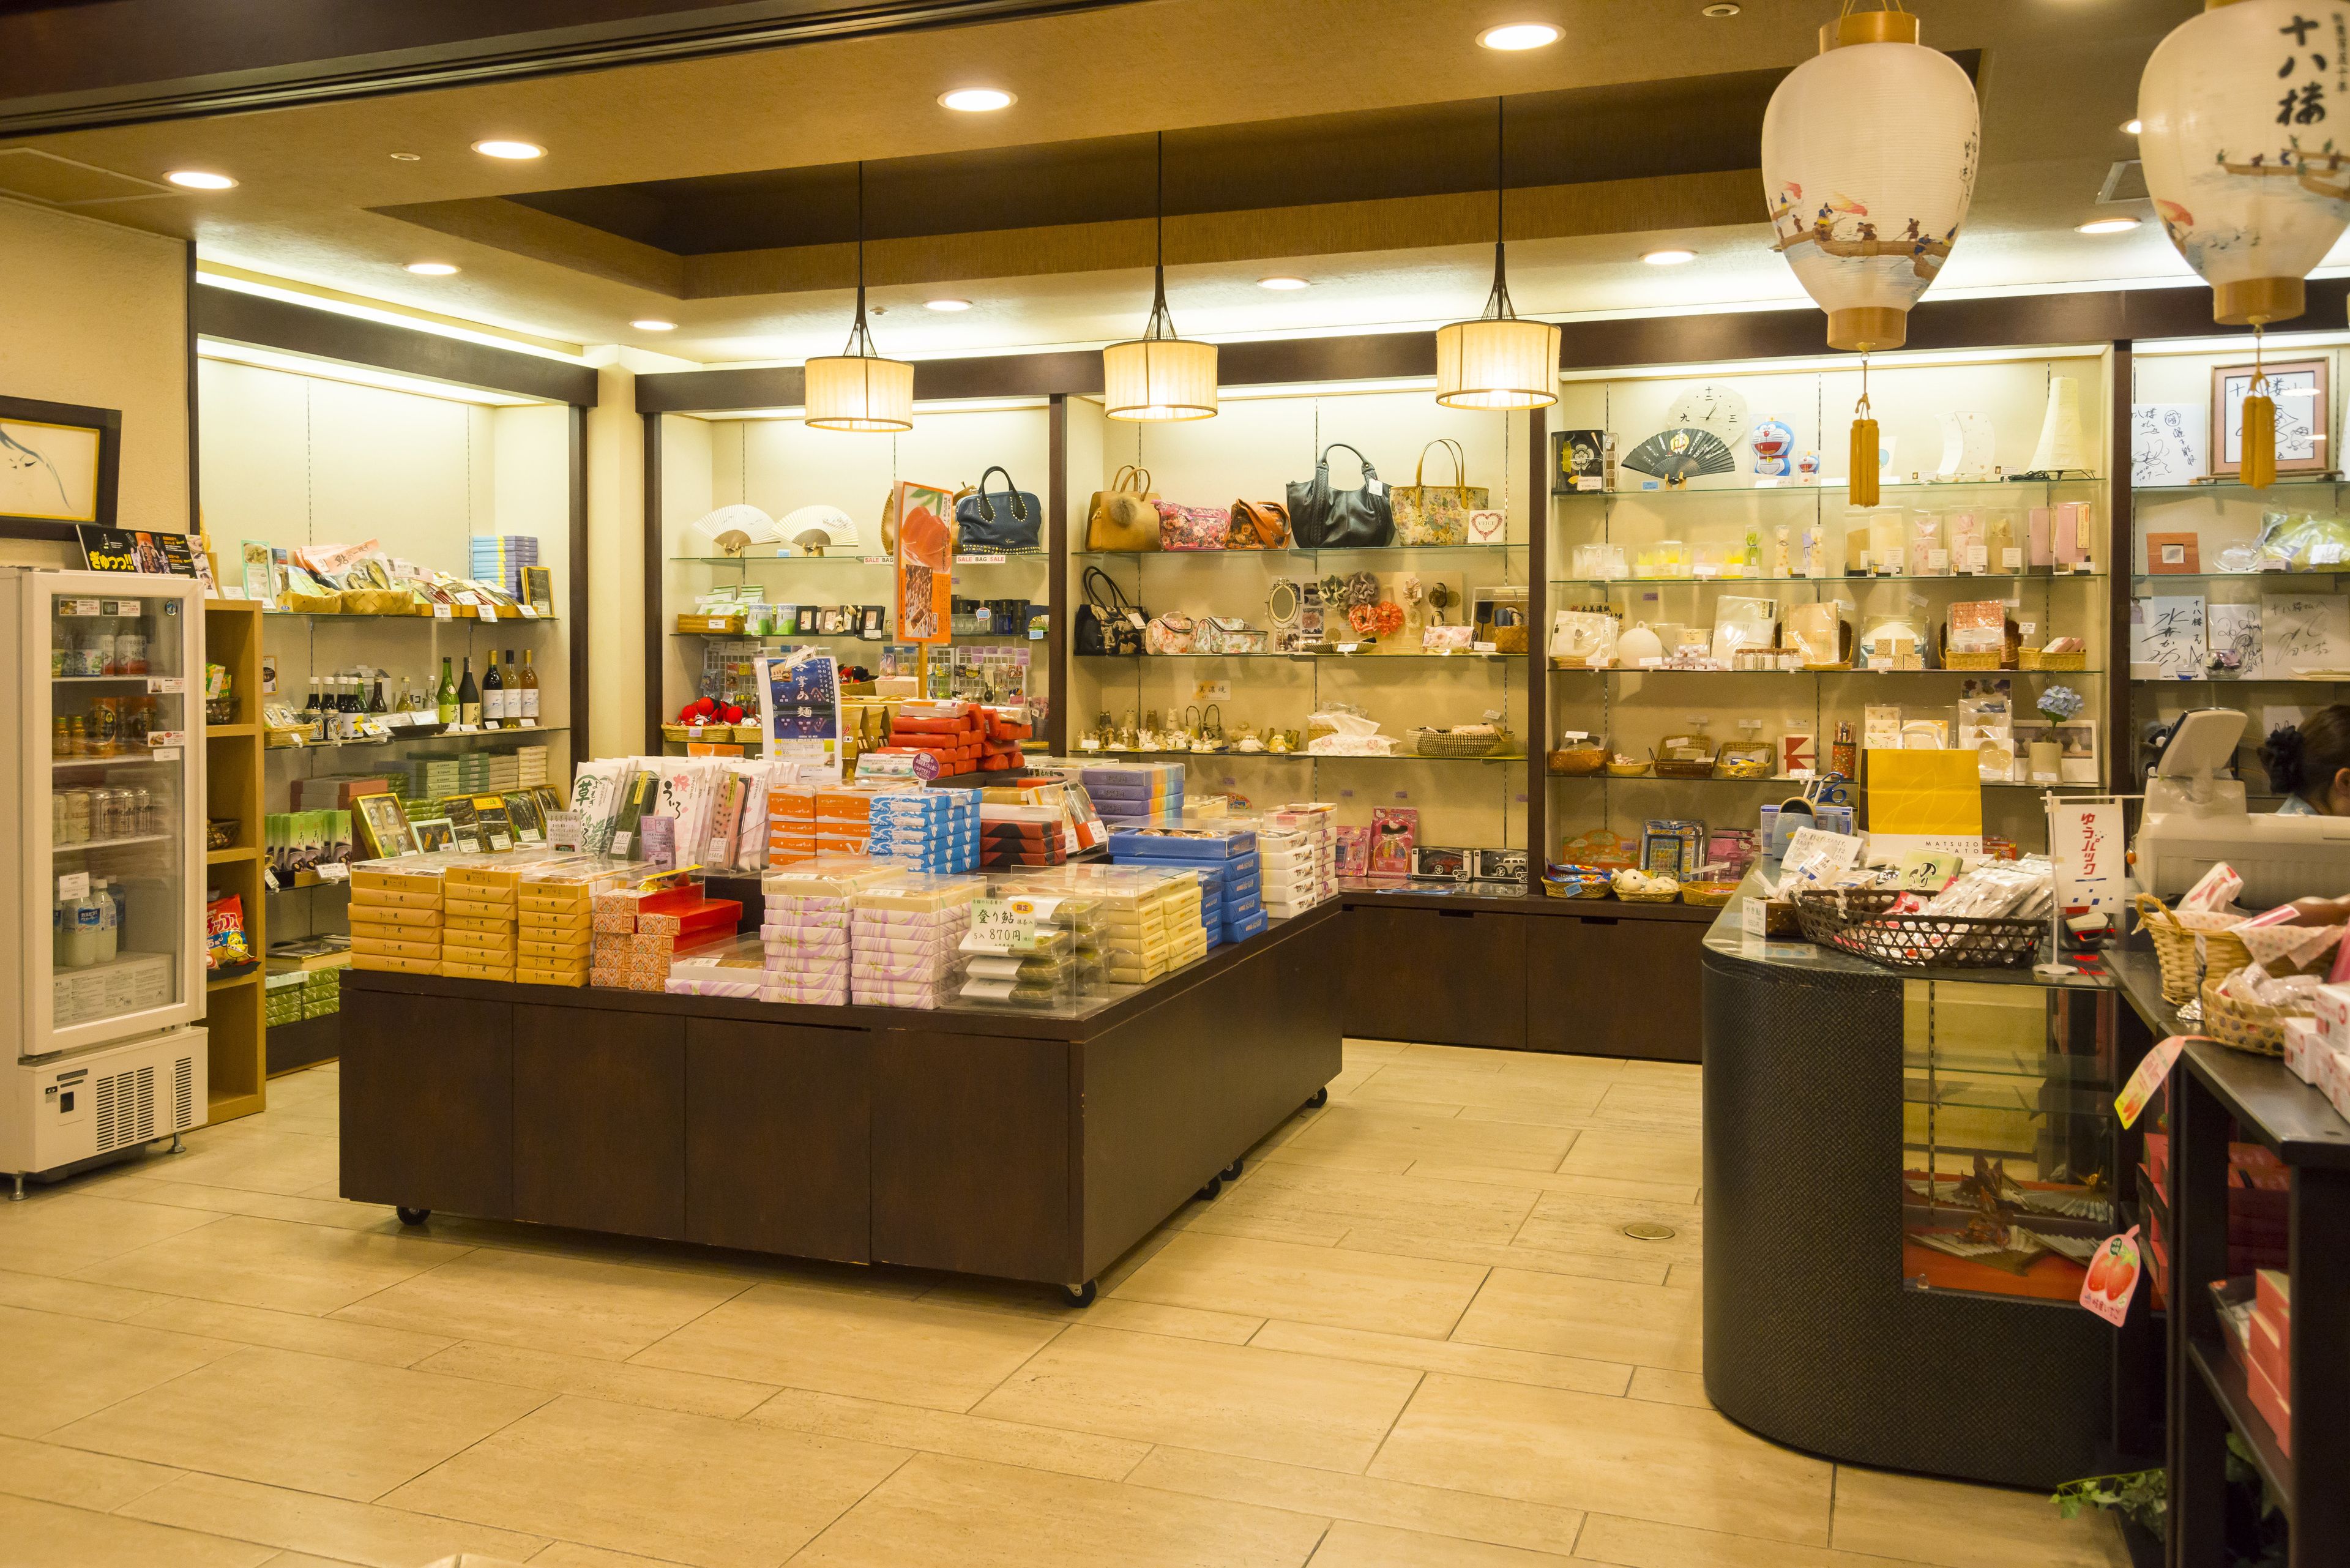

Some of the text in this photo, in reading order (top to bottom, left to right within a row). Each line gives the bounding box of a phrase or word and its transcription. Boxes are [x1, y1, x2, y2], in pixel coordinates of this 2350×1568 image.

[1704, 386, 1714, 401] 十二
[1680, 413, 1690, 422] 九
[673, 774, 690, 793] 桜
[575, 780, 591, 806] 草
[2081, 813, 2100, 875] ゆうパック
[977, 909, 1014, 924] 登り鮎
[990, 928, 1020, 941] 870円
